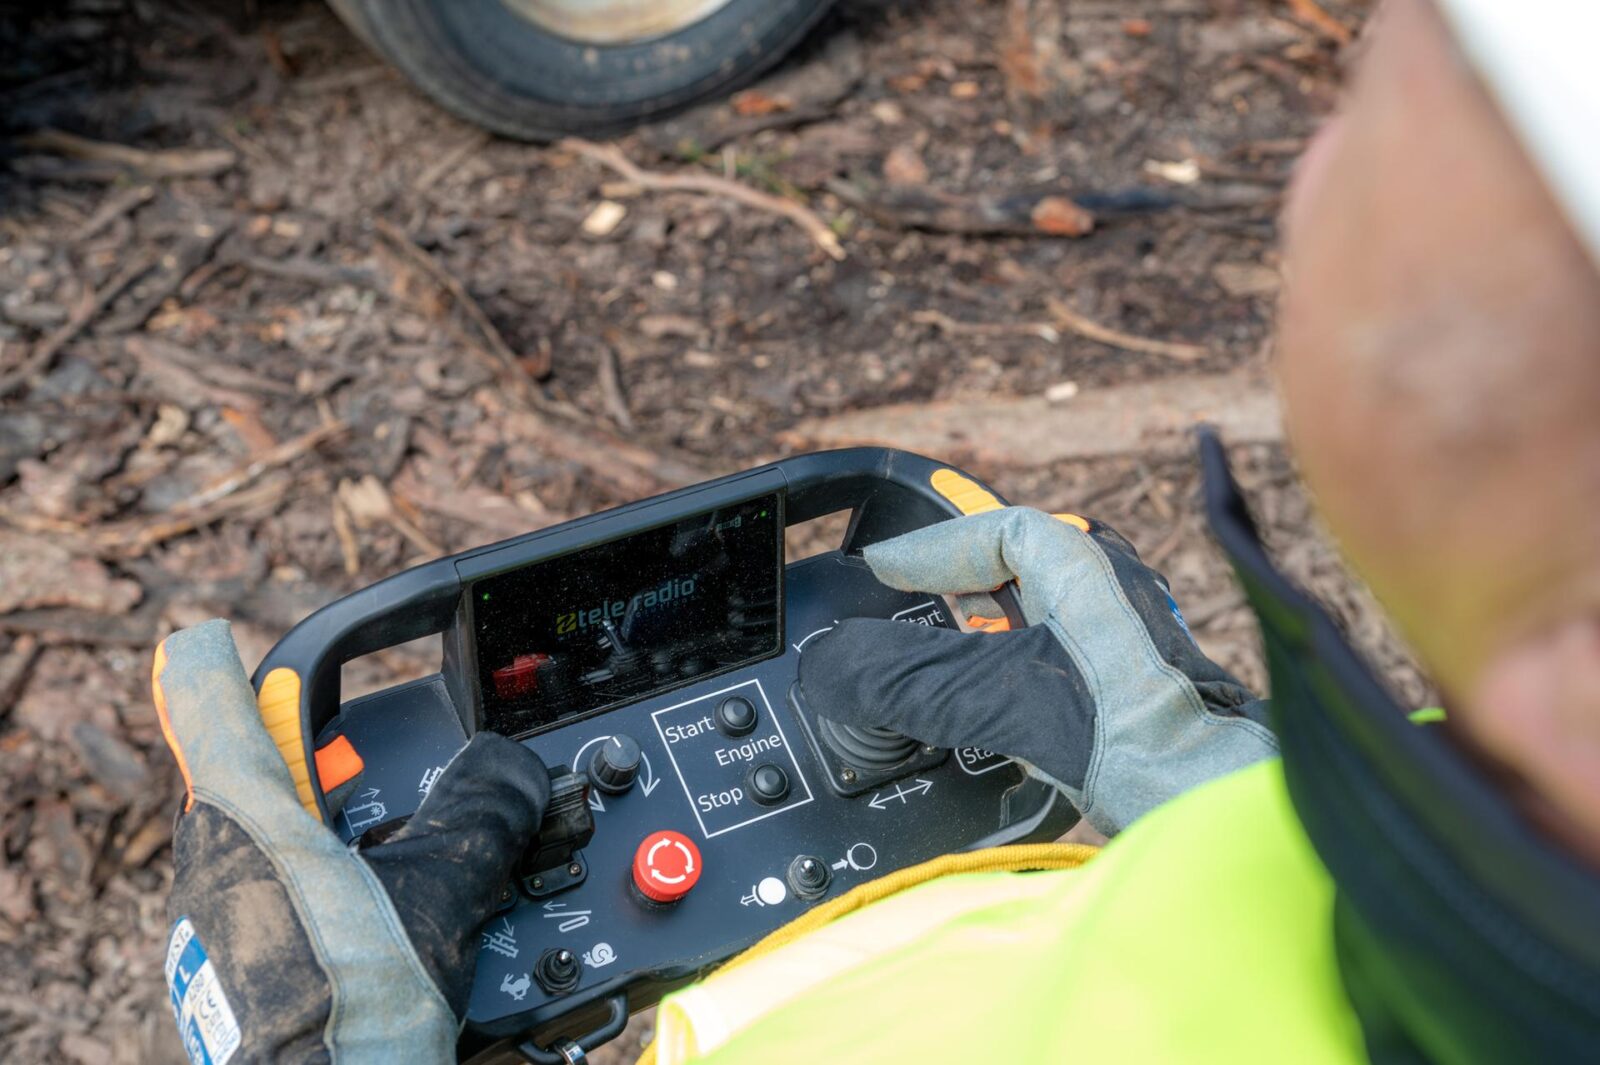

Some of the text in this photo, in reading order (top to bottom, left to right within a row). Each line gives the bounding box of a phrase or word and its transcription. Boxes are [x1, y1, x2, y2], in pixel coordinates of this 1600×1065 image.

[577, 598, 626, 628] tele
[633, 577, 696, 611] radio
[901, 609, 945, 626] art
[665, 715, 716, 744] Start
[714, 734, 782, 767] Engine
[962, 746, 995, 765] Sta
[697, 786, 744, 813] Stop
